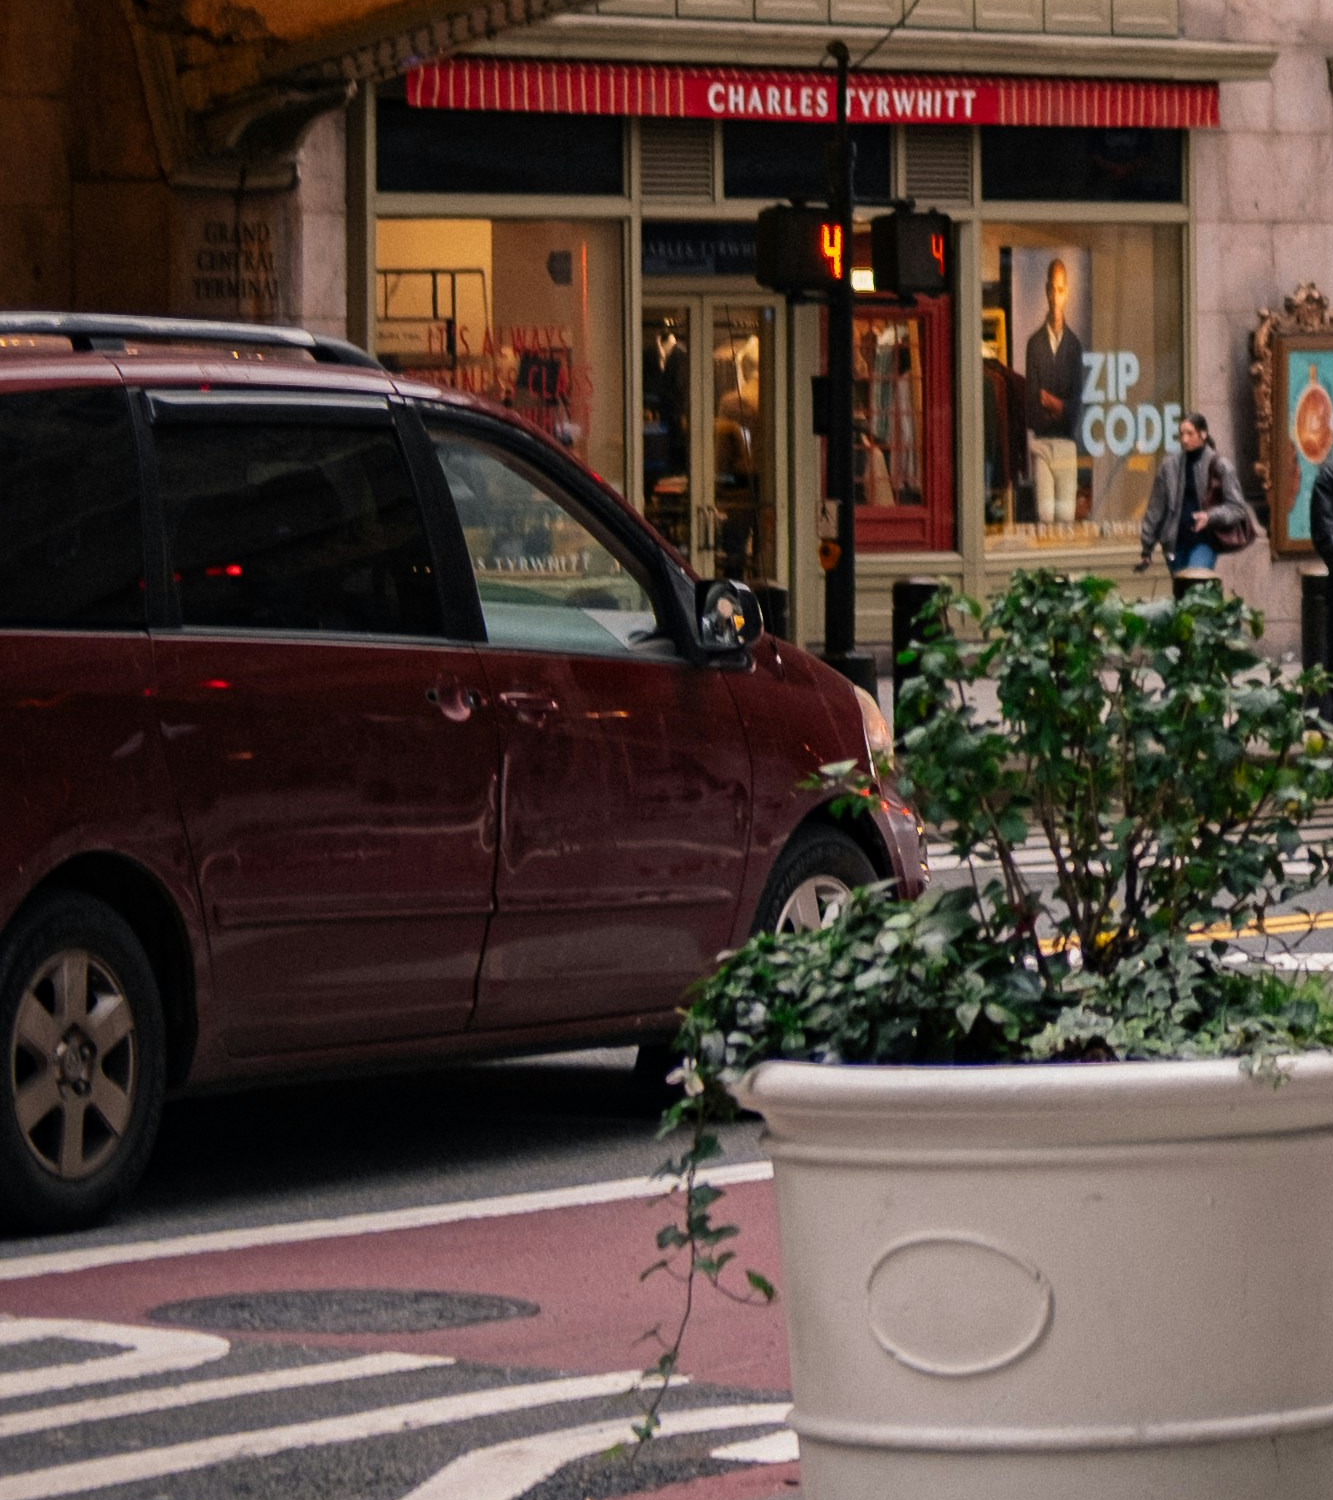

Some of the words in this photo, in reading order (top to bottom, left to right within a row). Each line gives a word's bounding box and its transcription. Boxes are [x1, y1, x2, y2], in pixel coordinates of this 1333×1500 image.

[708, 82, 829, 117] CHARLES
[846, 85, 976, 118] TYRWHITT
[203, 220, 271, 243] GRAND
[197, 248, 275, 271] CENTRAL
[821, 223, 842, 279] 4
[193, 277, 280, 299] TERMINAL
[428, 325, 470, 358] ITS
[1082, 351, 1140, 403] ZIP
[1082, 403, 1181, 457] CODE
